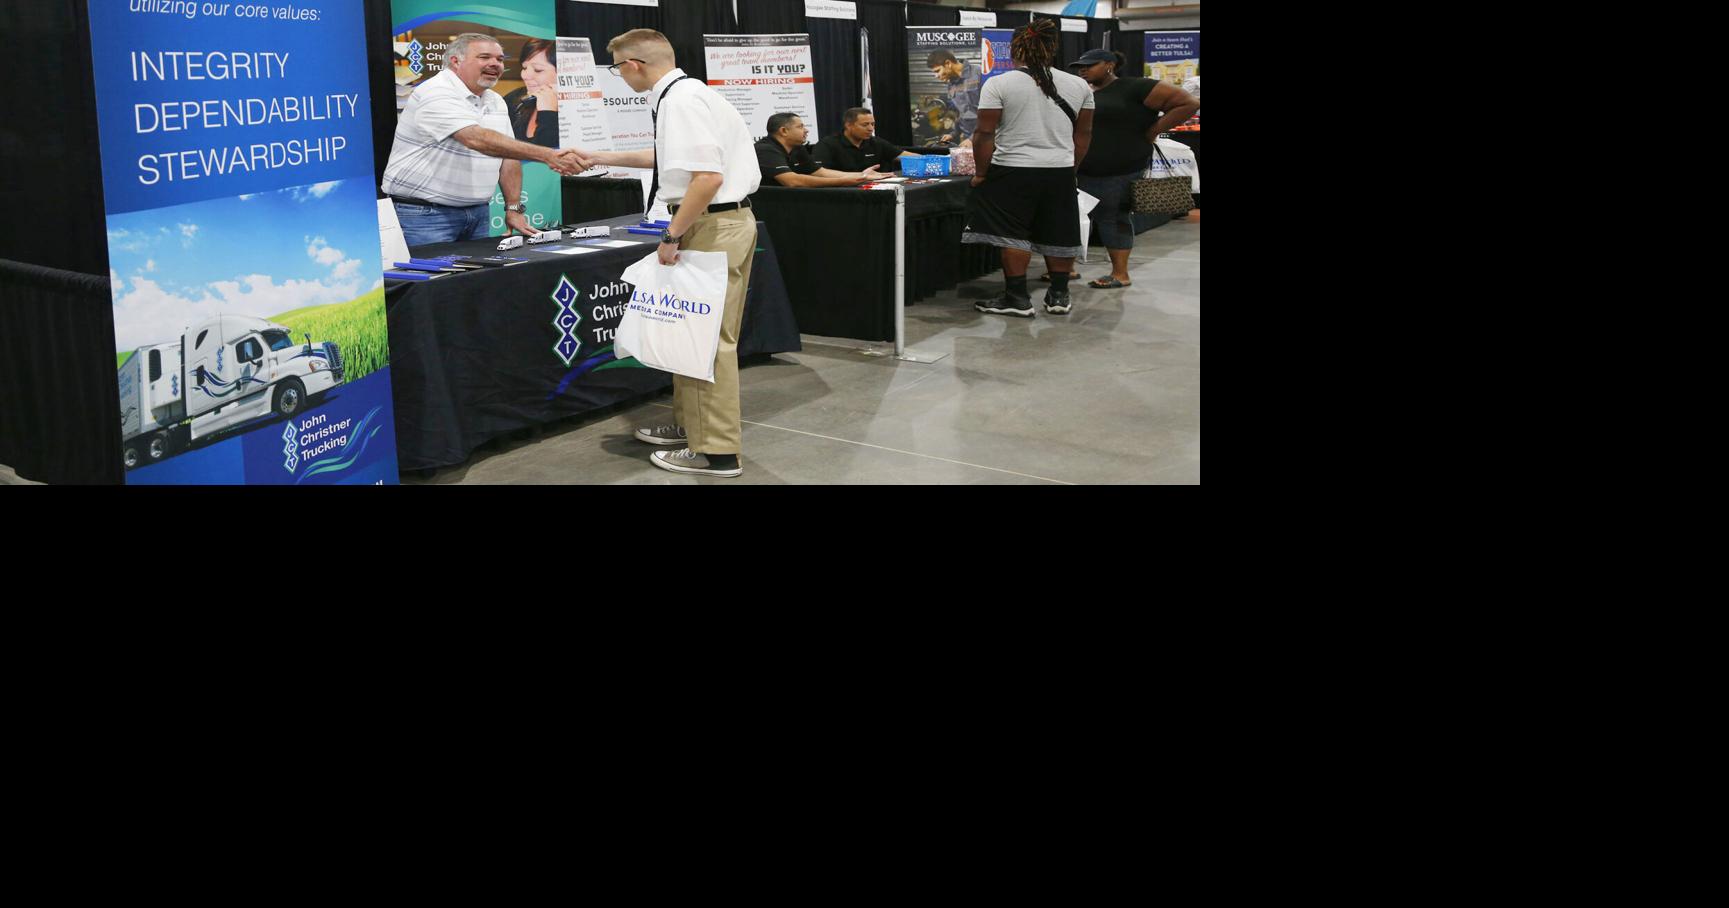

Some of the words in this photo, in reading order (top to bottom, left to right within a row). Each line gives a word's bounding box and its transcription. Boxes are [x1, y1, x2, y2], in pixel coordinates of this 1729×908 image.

[129, 0, 197, 19] utilizing
[202, 2, 229, 16] our
[234, 4, 269, 18] core
[272, 5, 321, 21] values:
[425, 42, 449, 51] Joh
[426, 52, 445, 61] Chr
[131, 51, 289, 81] INTEGRITY
[426, 63, 444, 71] Tru
[752, 66, 761, 74] IS
[764, 65, 774, 73] IT
[777, 64, 805, 74] YOU?
[558, 75, 565, 87] IS
[566, 75, 573, 86] IT
[603, 96, 646, 106] esource
[134, 94, 359, 133] DEPENDABILITY
[138, 136, 346, 185] STEWARDSHIP
[589, 282, 629, 300] John
[632, 291, 655, 305] LSA
[659, 292, 711, 315] WORLD
[299, 414, 326, 432] John
[300, 418, 351, 447] Christner
[301, 435, 347, 461] Trucking
